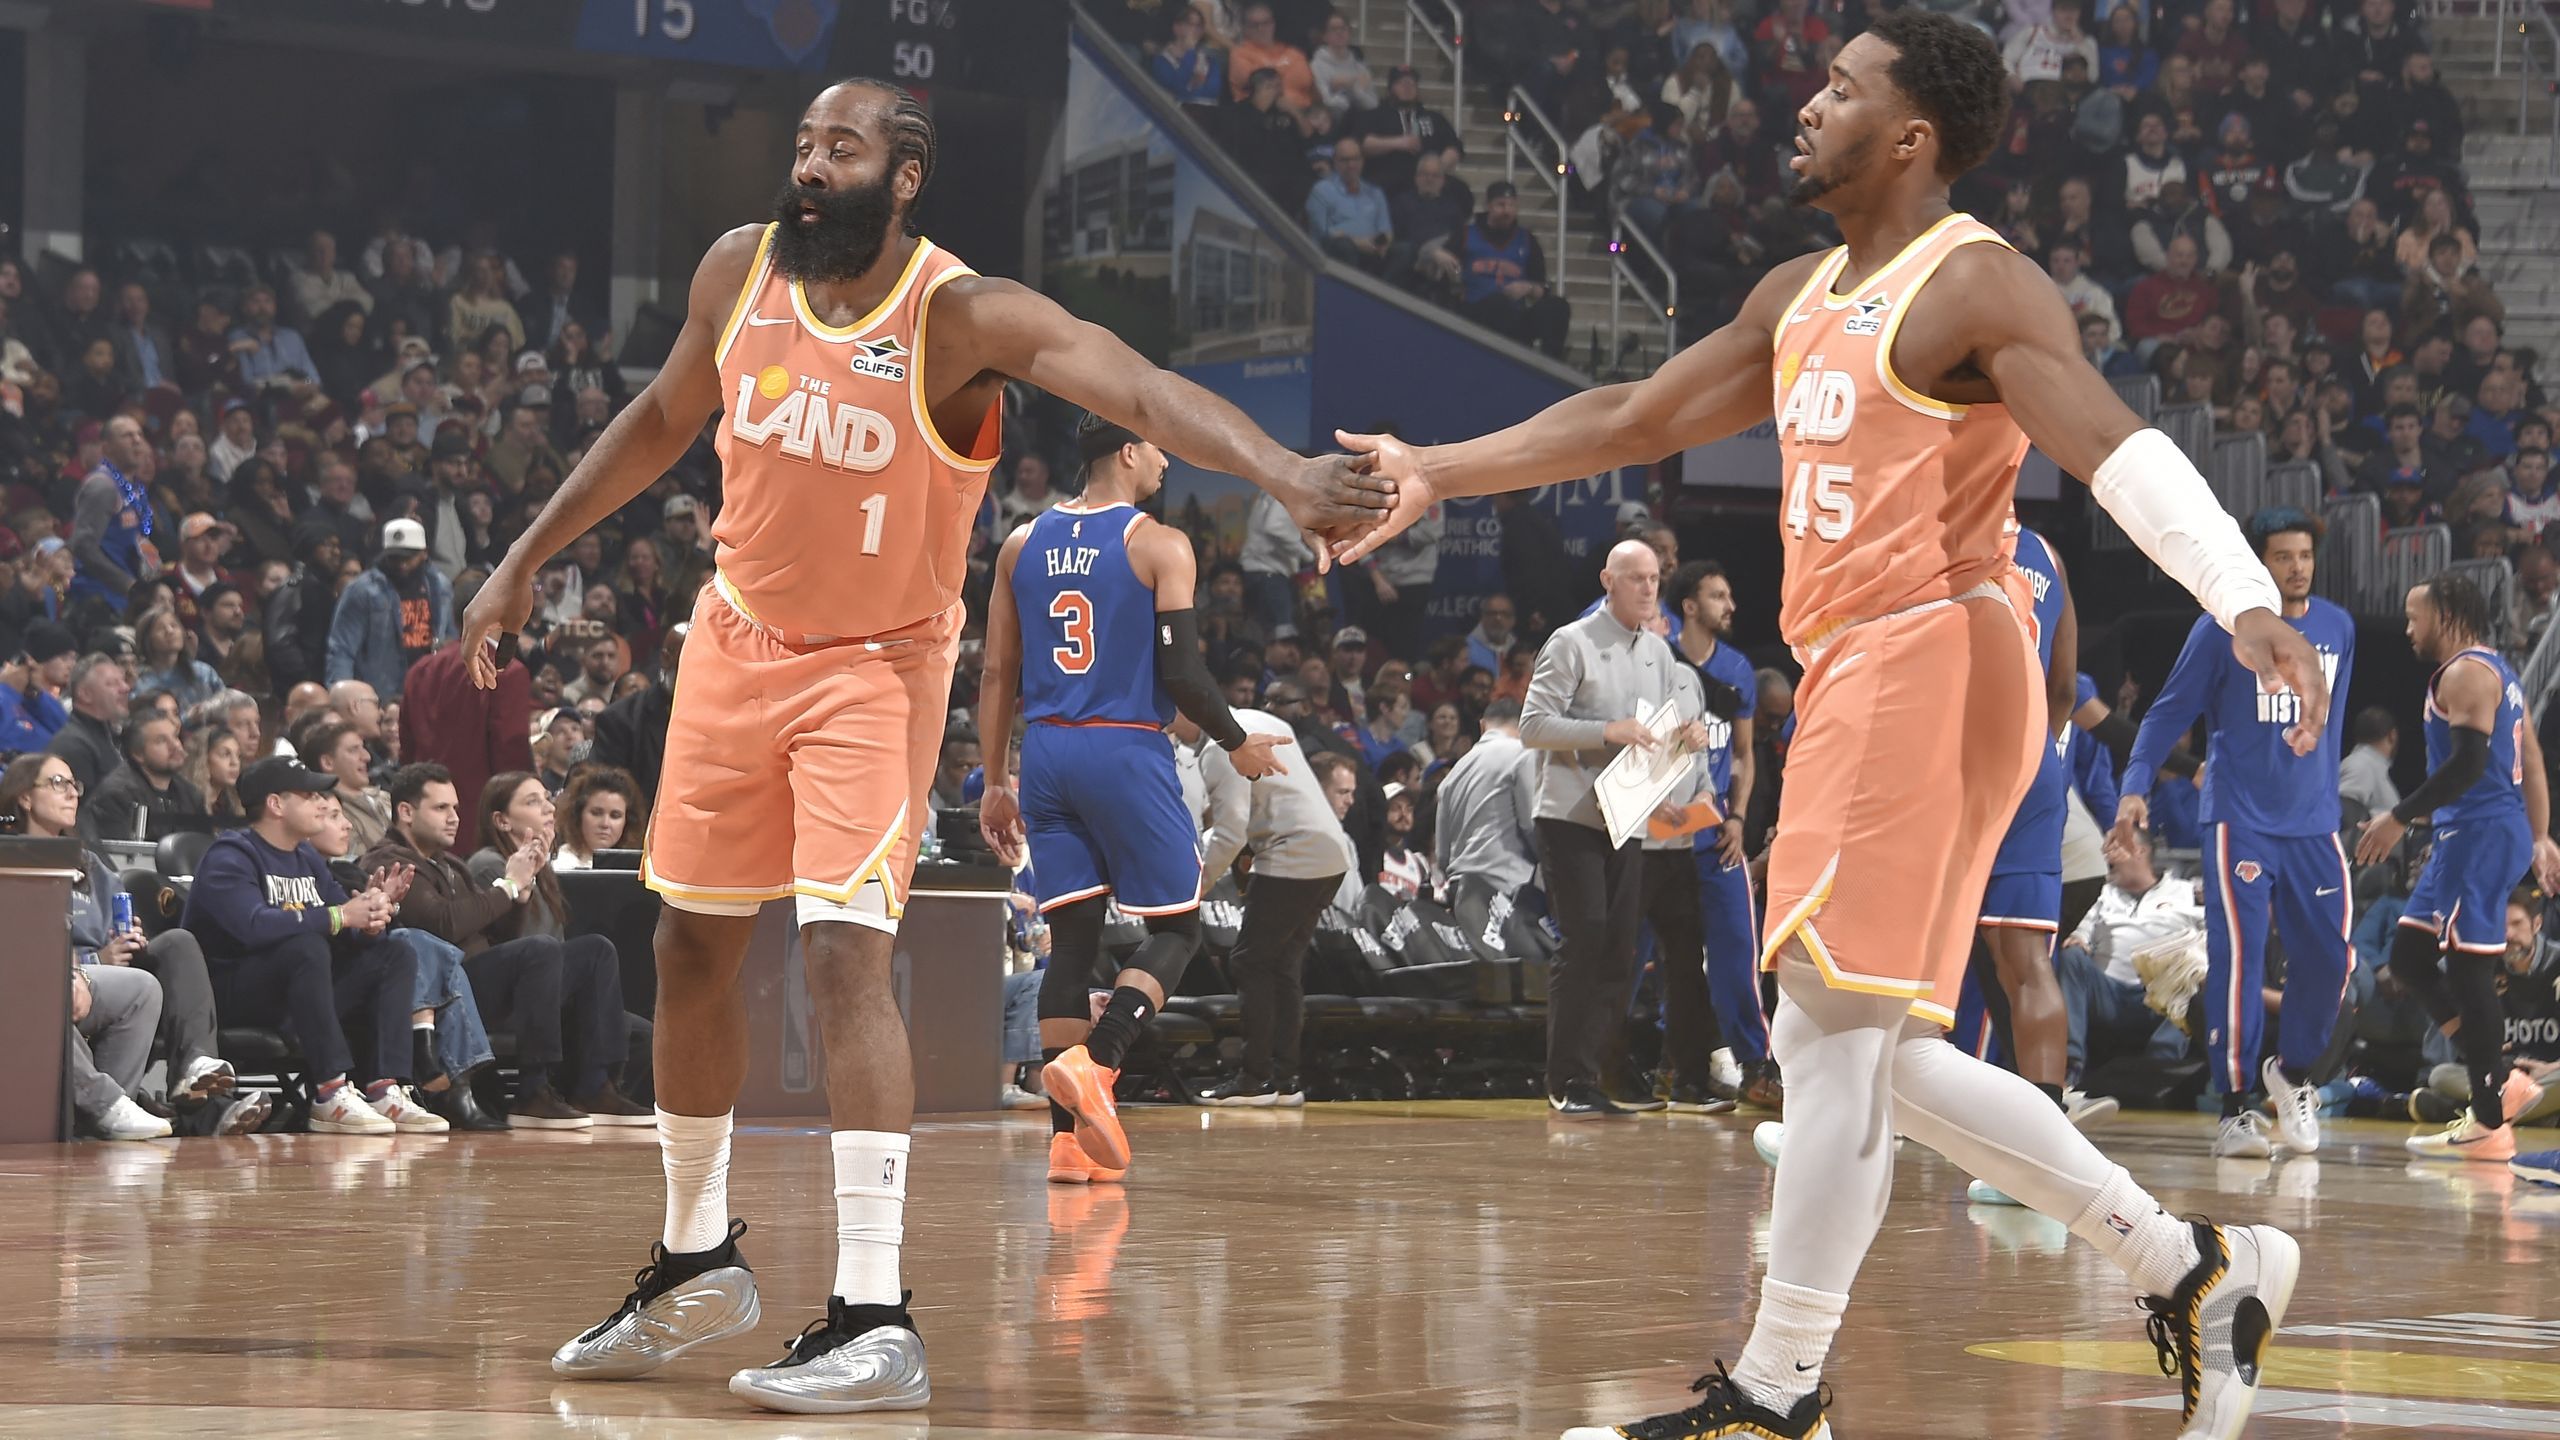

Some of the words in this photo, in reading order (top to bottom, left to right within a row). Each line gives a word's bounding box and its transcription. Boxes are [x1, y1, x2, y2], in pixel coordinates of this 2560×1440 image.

[632, 0, 695, 40] 15
[894, 42, 934, 78] 50
[799, 374, 832, 395] THE
[853, 358, 905, 379] CLIFFS
[732, 373, 897, 474] LAND
[1787, 460, 1856, 540] 45
[859, 491, 889, 557] 1
[1045, 546, 1100, 577] HART
[1049, 589, 1096, 675] 3
[2504, 1017, 2559, 1044] HOTO
